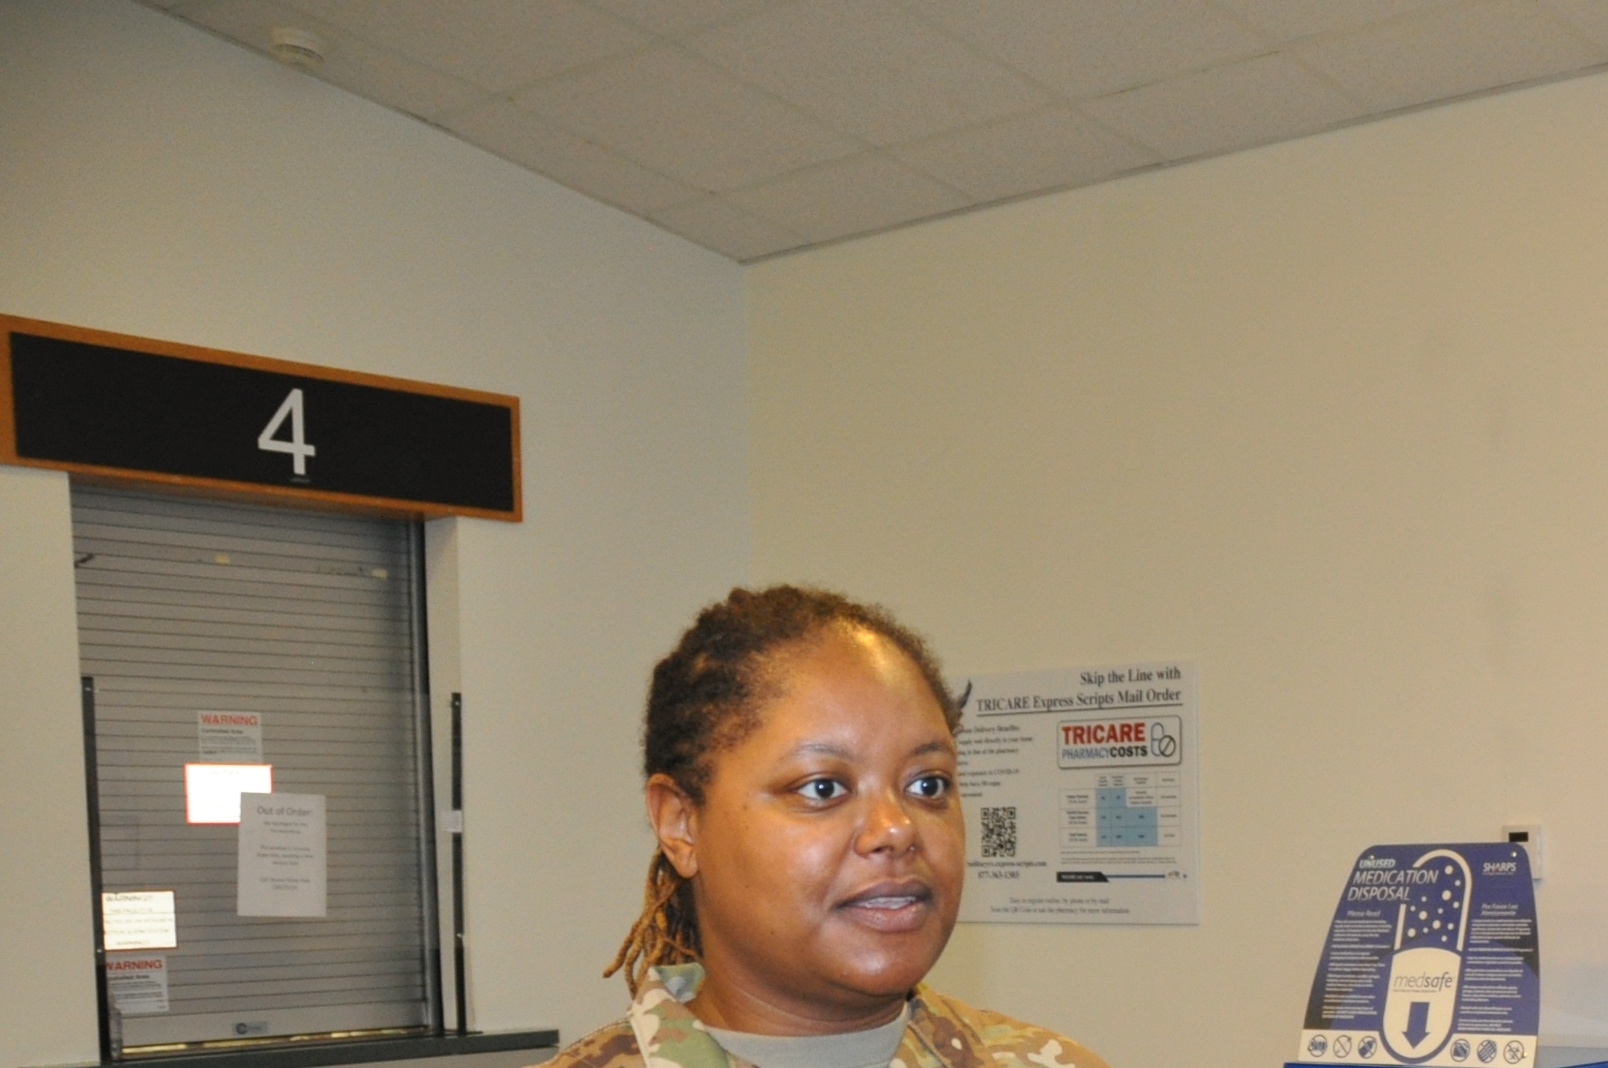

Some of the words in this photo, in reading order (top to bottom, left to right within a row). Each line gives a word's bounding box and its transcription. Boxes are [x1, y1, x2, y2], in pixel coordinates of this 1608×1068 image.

[258, 388, 316, 476] 4
[1080, 671, 1104, 687] Skip
[1107, 670, 1125, 683] the
[1128, 669, 1153, 682] Line
[1156, 666, 1181, 680] with
[977, 696, 1030, 712] TRICARE
[1033, 695, 1074, 711] Express
[1076, 693, 1115, 709] Scripts
[1117, 690, 1143, 703] Mail
[1146, 688, 1181, 701] Order
[201, 715, 258, 726] WARNING
[1062, 722, 1146, 745] TRICARE
[257, 806, 274, 816] Out
[276, 805, 286, 816] of
[1359, 859, 1396, 869] UNUSED
[1482, 862, 1517, 873] SHARPS
[1352, 869, 1440, 885] MEDICATION
[1347, 886, 1411, 901] DISPOSAL
[1393, 971, 1453, 992] medsafe
